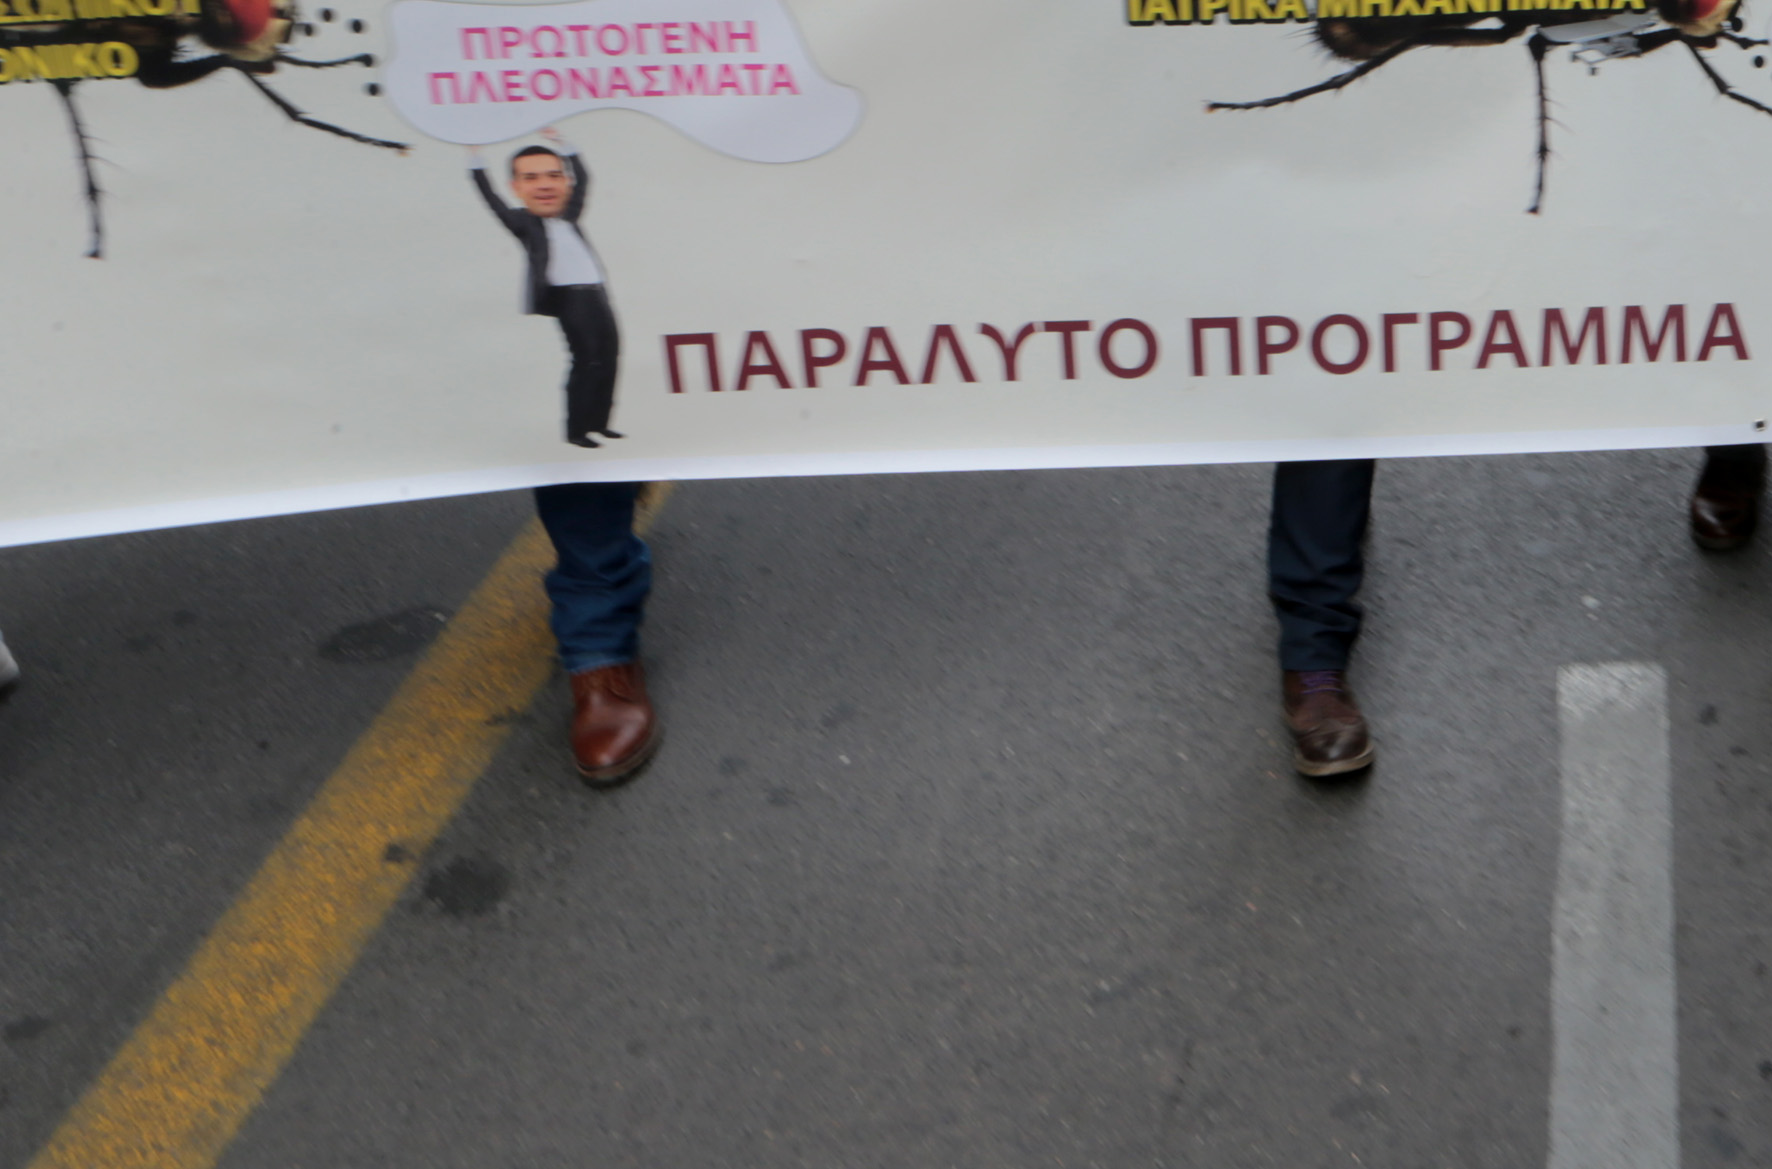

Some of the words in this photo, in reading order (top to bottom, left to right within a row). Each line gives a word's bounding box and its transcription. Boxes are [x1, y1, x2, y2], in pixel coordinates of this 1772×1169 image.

[457, 19, 761, 61] ΠΡΩΤΟΓΕΝΗ
[424, 62, 802, 105] ΠΛΕΟΝΑΣΜΑΤΑ
[661, 316, 1159, 394] ΠΑΡΑΛΥΤΟ
[1186, 302, 1752, 377] ΠΡΟΓΡΑΜΜΑ
